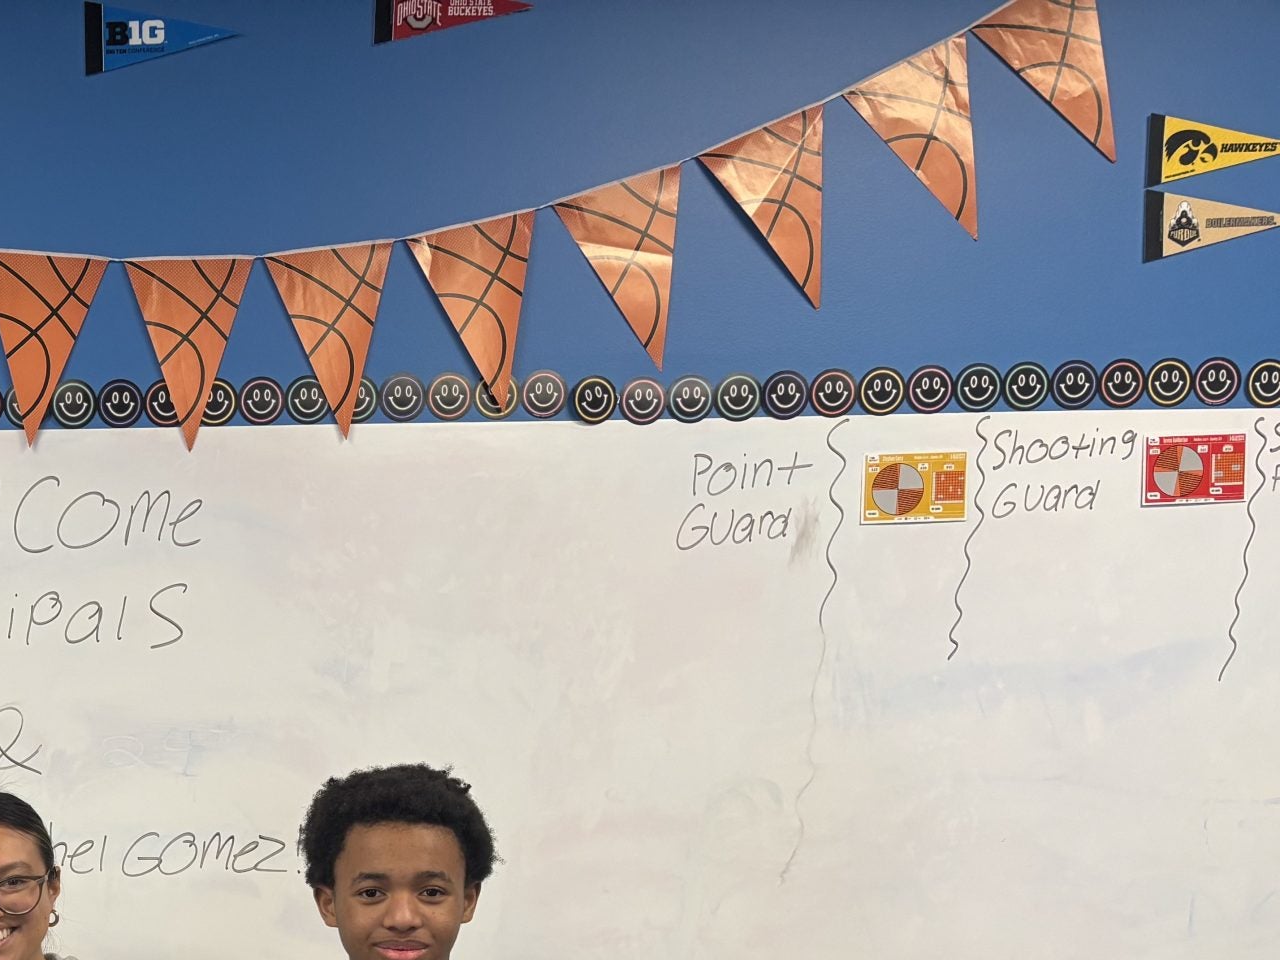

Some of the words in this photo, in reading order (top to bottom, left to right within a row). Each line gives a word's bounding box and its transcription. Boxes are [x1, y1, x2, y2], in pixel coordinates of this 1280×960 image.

[448, 6, 494, 16] BUCKEYES
[1220, 142, 1277, 153] HAWKEYES
[1169, 228, 1199, 242] PURDUE
[992, 427, 1138, 470] Shooting
[692, 451, 814, 496] Point
